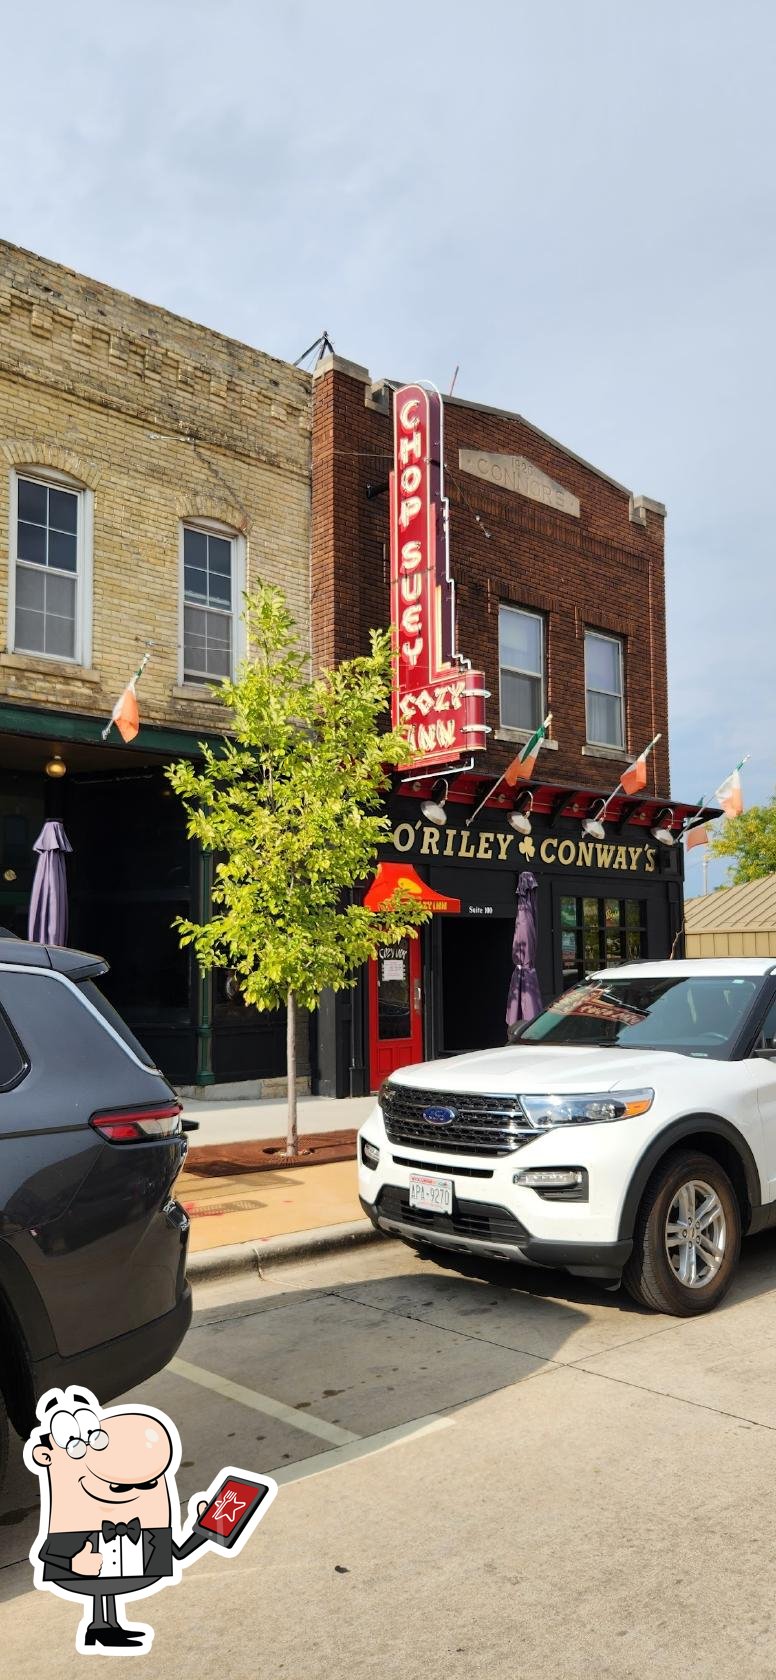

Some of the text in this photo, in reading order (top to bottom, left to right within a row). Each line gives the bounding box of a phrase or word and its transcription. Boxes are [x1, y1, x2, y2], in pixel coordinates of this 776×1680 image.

[399, 399, 422, 528] CHOP
[401, 540, 424, 666] SUEY
[400, 681, 466, 720] COZY
[406, 719, 456, 752] INN
[393, 820, 656, 873] O'RILEY CONWAY'S
[468, 905, 493, 915] Suite 100
